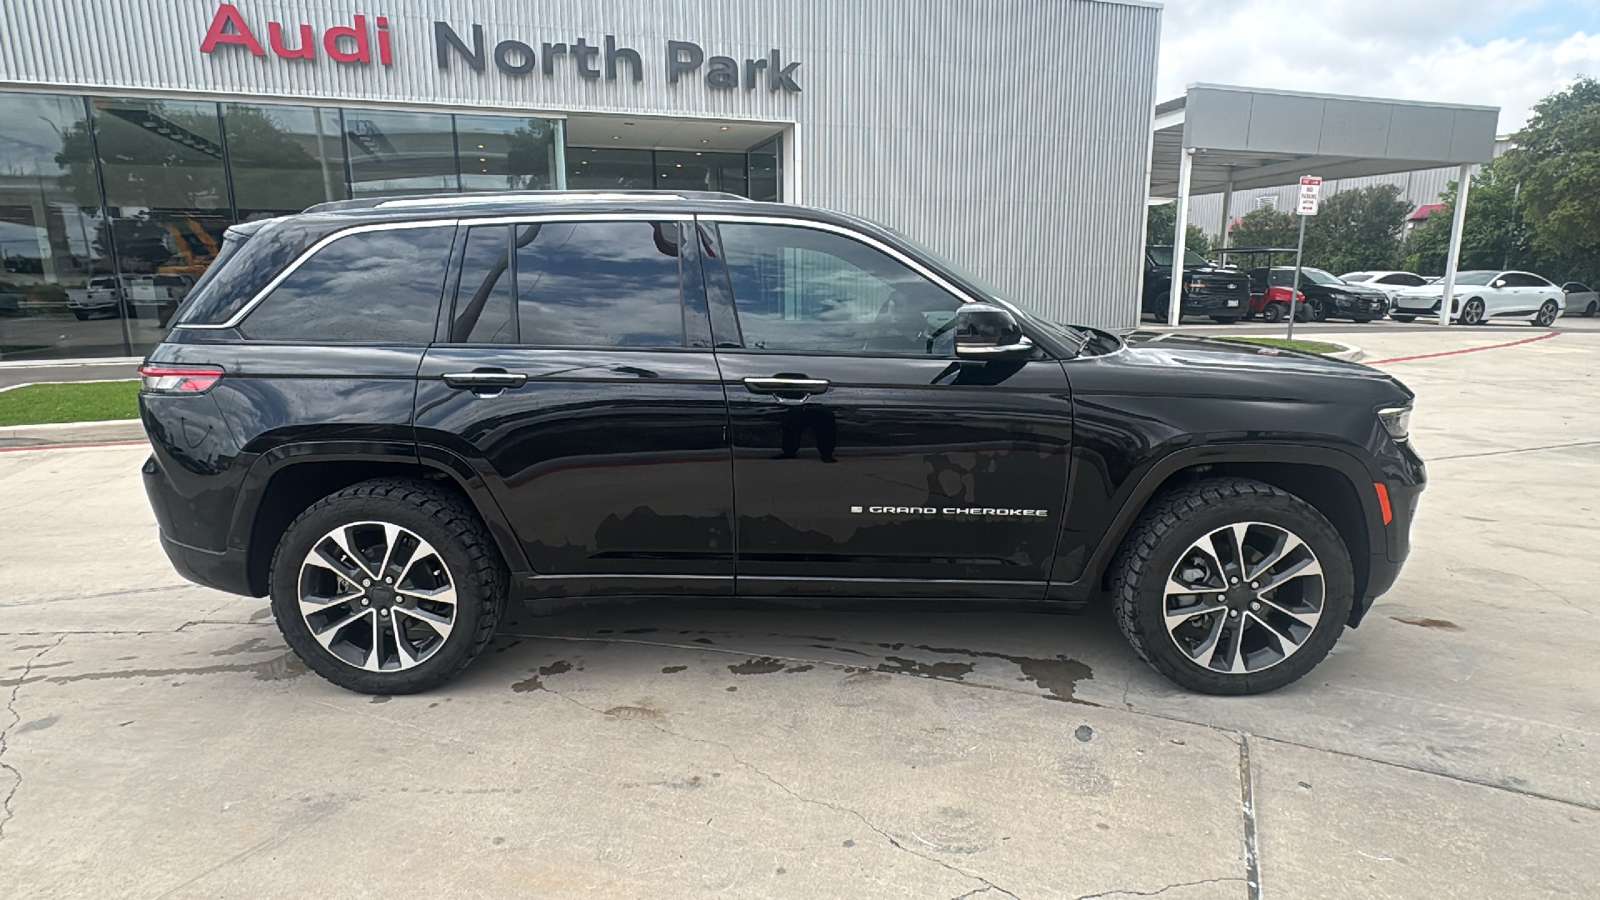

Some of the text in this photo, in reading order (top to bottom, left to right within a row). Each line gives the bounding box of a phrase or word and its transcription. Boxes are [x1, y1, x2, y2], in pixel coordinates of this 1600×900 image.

[200, 3, 802, 93] Audi North Park
[869, 506, 1048, 517] GRAND CHEROKEE
